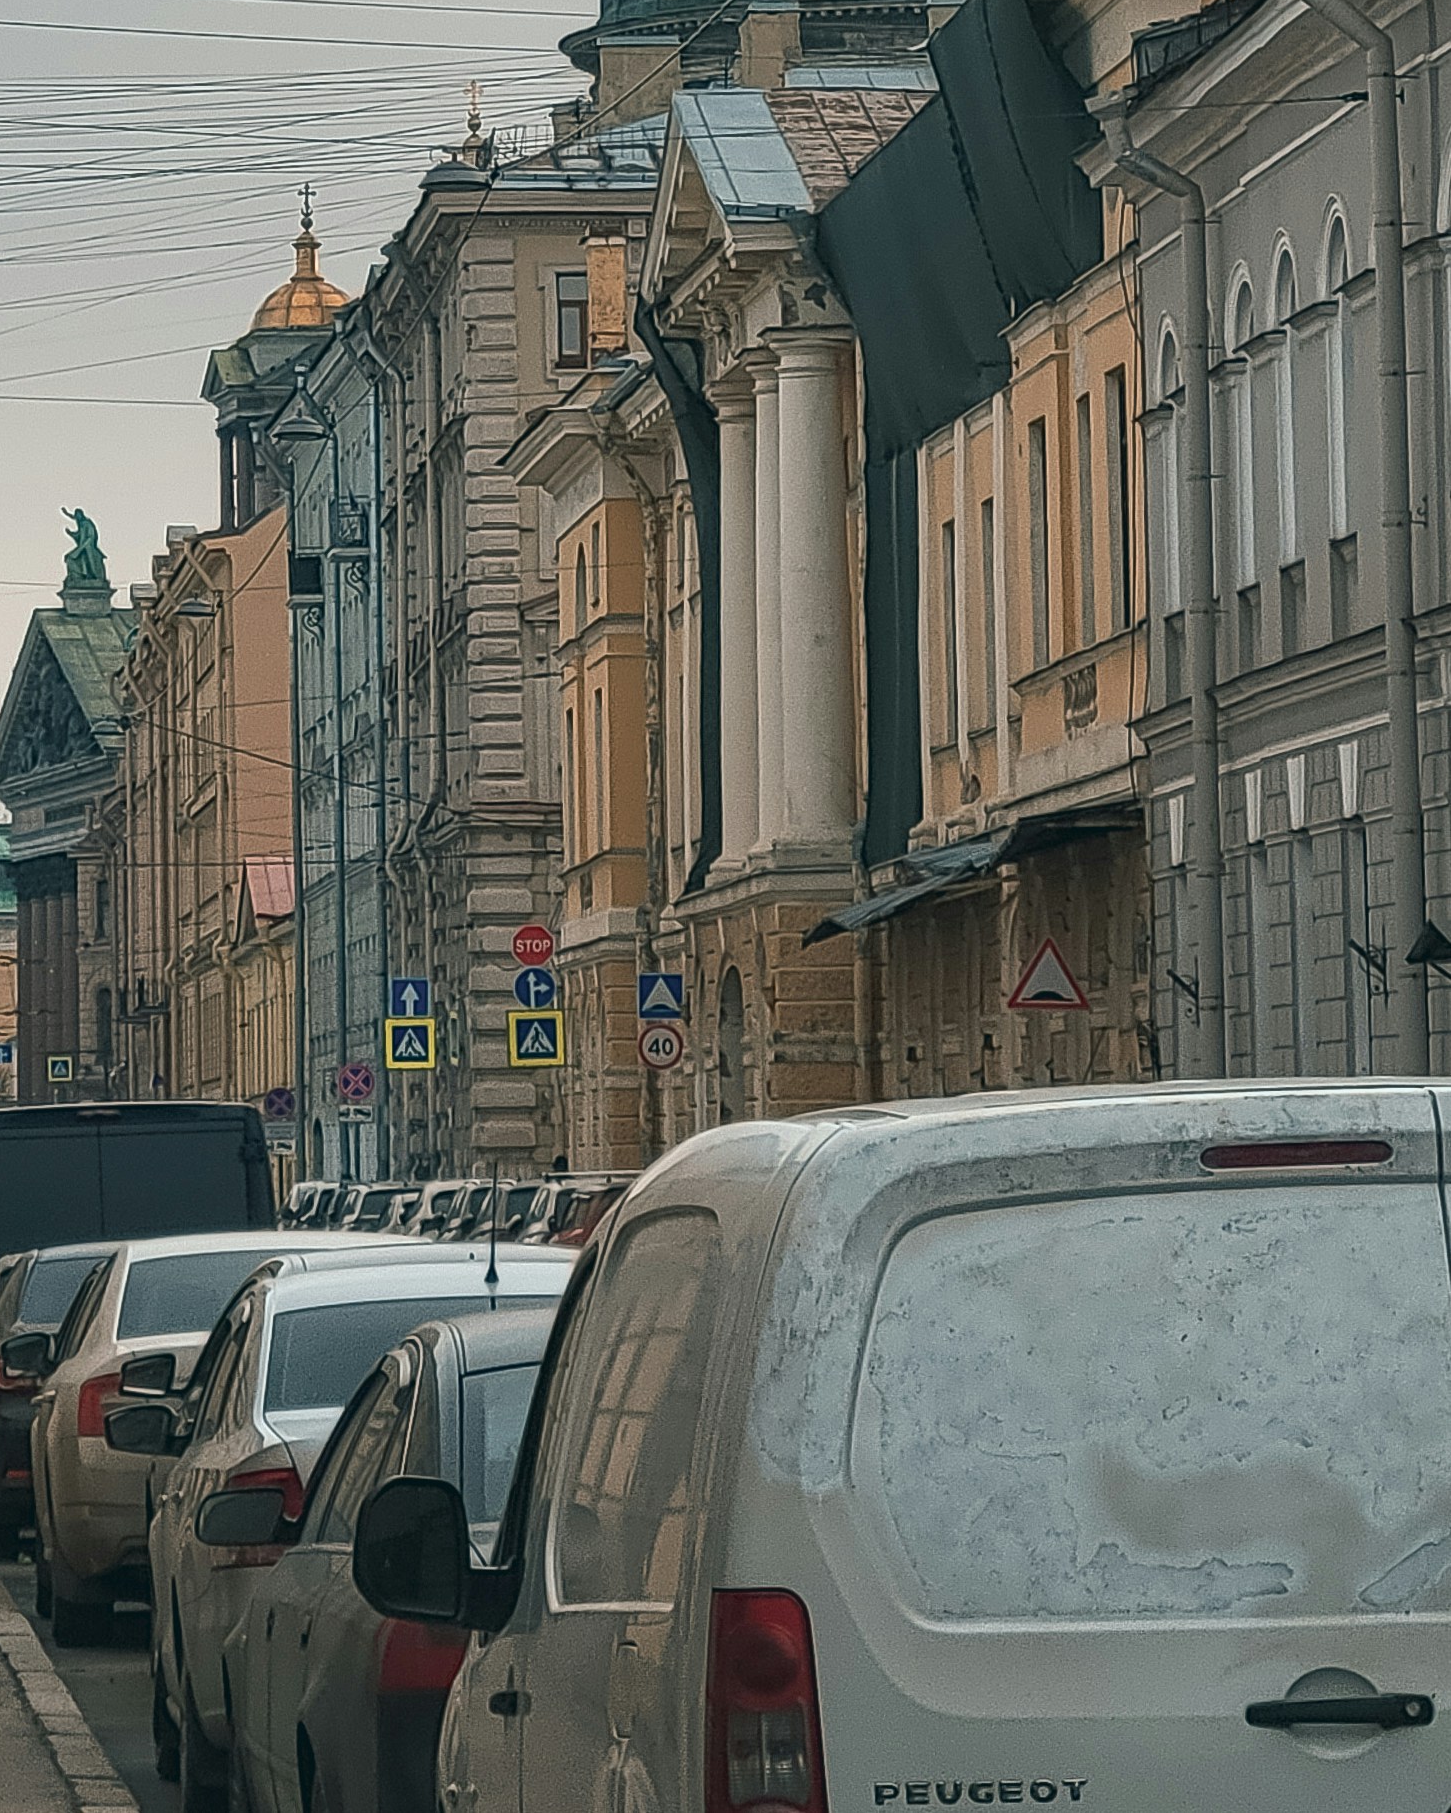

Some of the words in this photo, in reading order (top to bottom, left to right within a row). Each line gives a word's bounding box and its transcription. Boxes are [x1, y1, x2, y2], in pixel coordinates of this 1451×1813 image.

[516, 940, 551, 953] STOP
[648, 1038, 674, 1056] 40
[873, 1778, 1088, 1806] PEUGEOT
